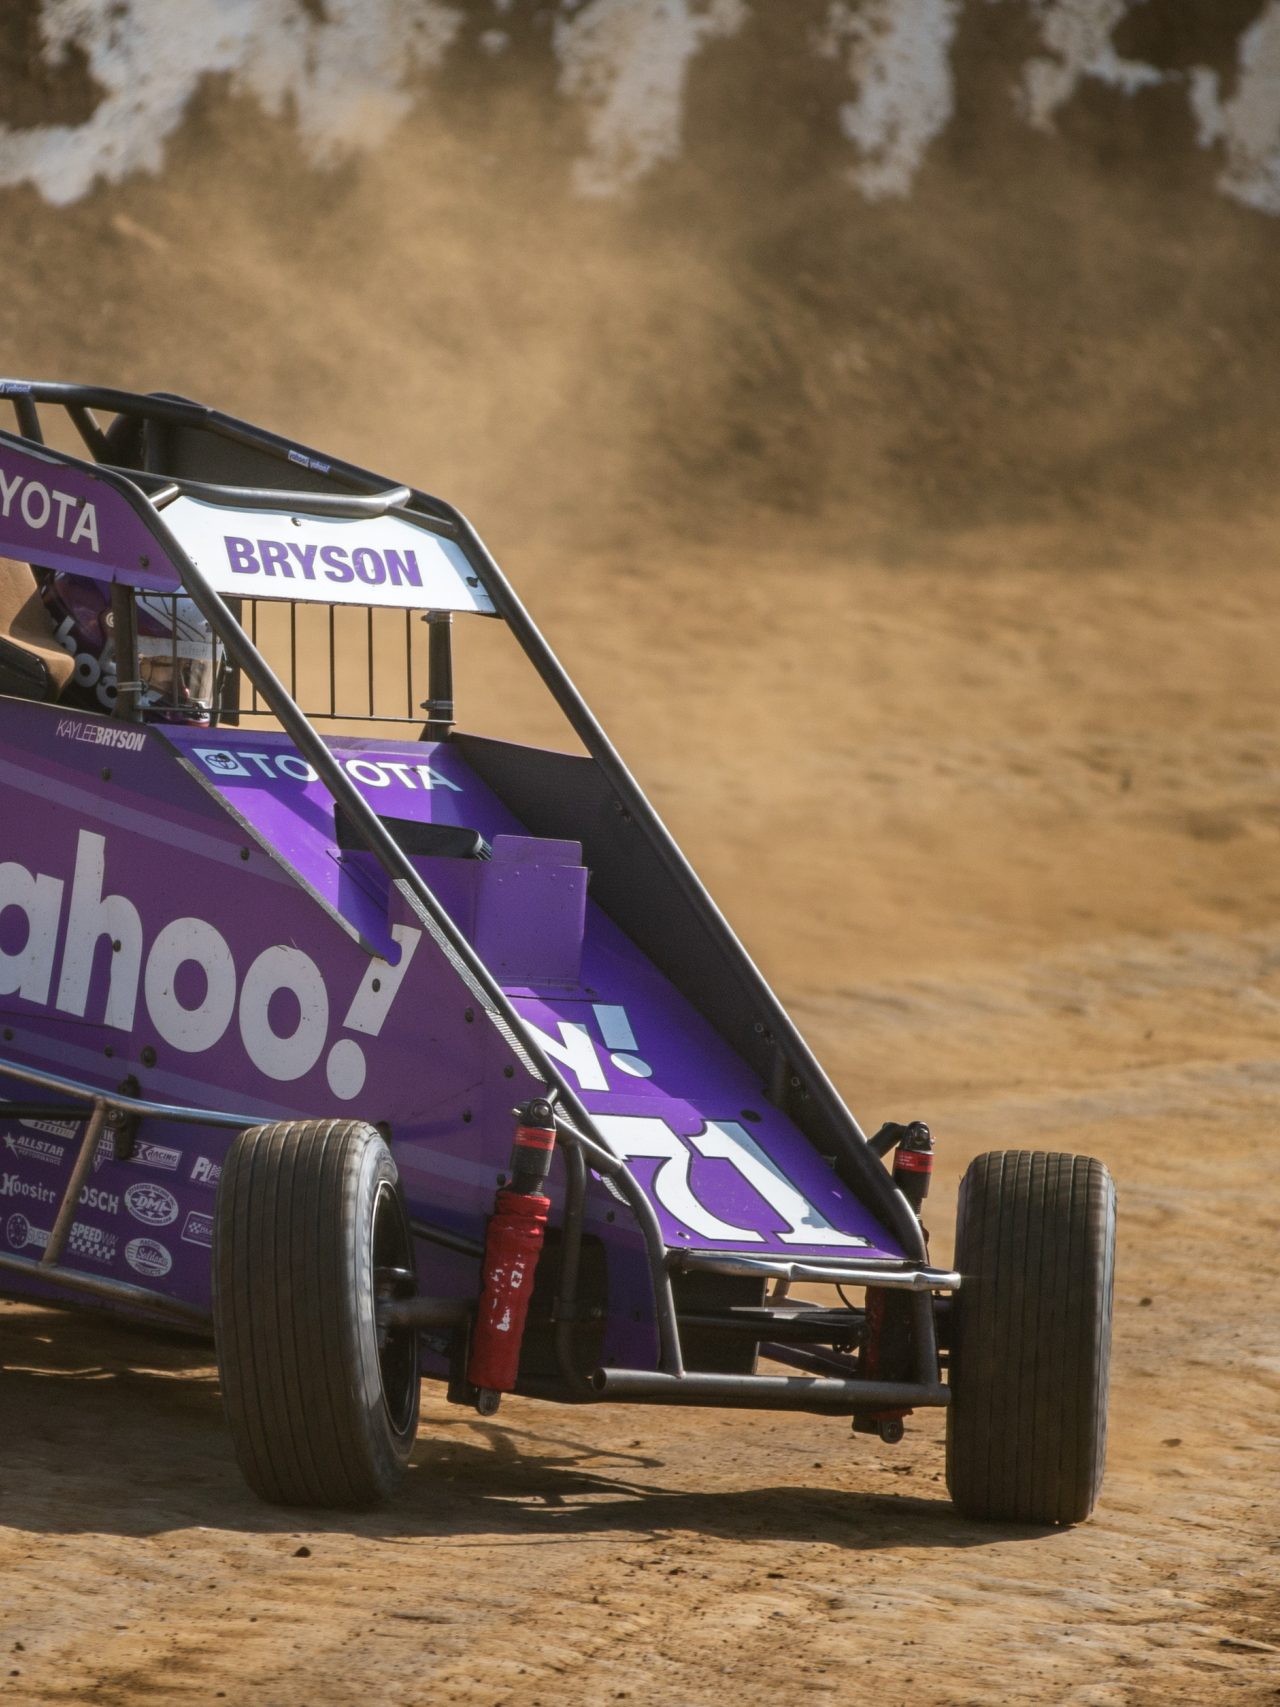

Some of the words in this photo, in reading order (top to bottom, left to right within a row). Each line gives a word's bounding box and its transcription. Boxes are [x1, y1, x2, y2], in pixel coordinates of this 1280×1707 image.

[224, 535, 424, 588] BRYSON
[236, 752, 463, 792] TOOTA
[17, 1136, 65, 1158] ALLSTAR
[79, 1185, 120, 1215] OSCH
[591, 1113, 876, 1249] 71
